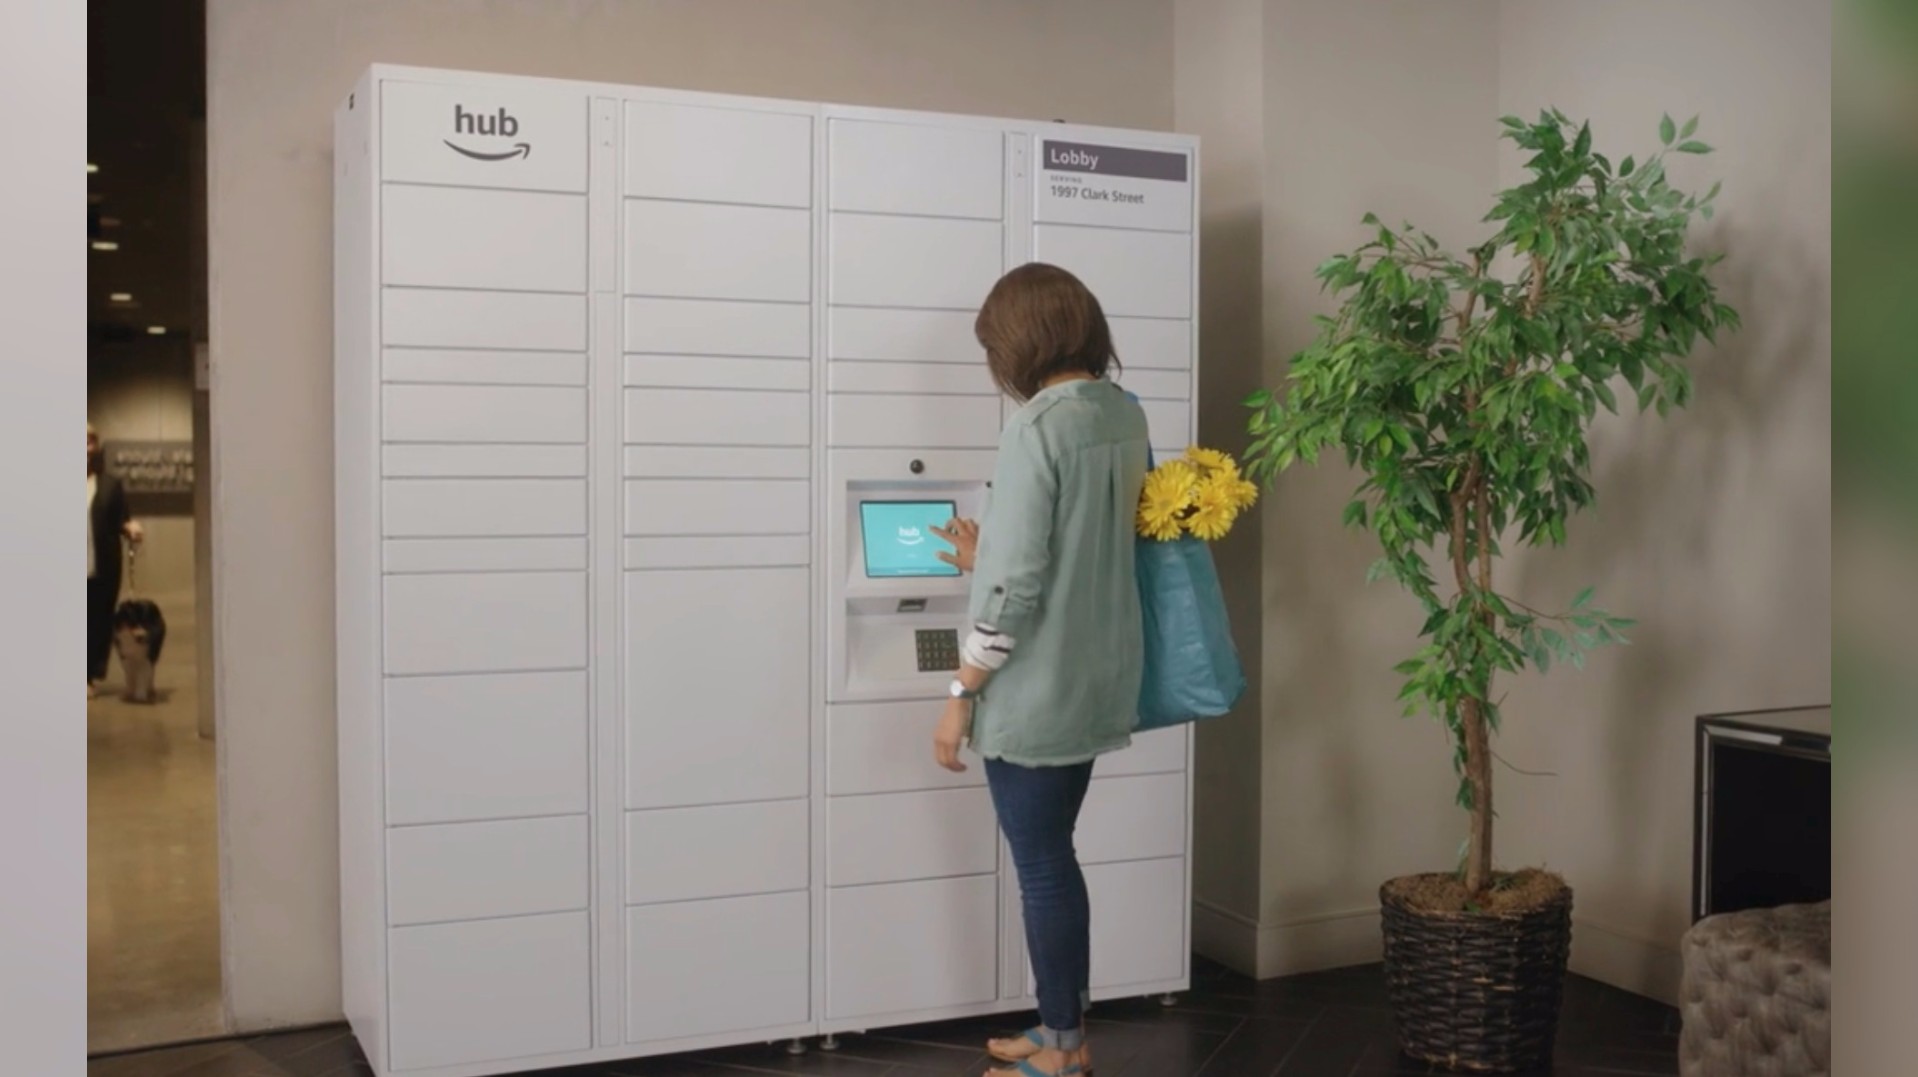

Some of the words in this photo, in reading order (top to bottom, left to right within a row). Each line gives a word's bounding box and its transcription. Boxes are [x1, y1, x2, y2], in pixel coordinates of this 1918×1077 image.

[455, 104, 518, 137] hub
[1051, 148, 1099, 170] Lobby
[1050, 175, 1082, 184] SERVING
[1051, 185, 1078, 199] 1997
[1081, 187, 1110, 201] Clark
[1112, 190, 1145, 204] Street
[898, 525, 920, 537] hub
